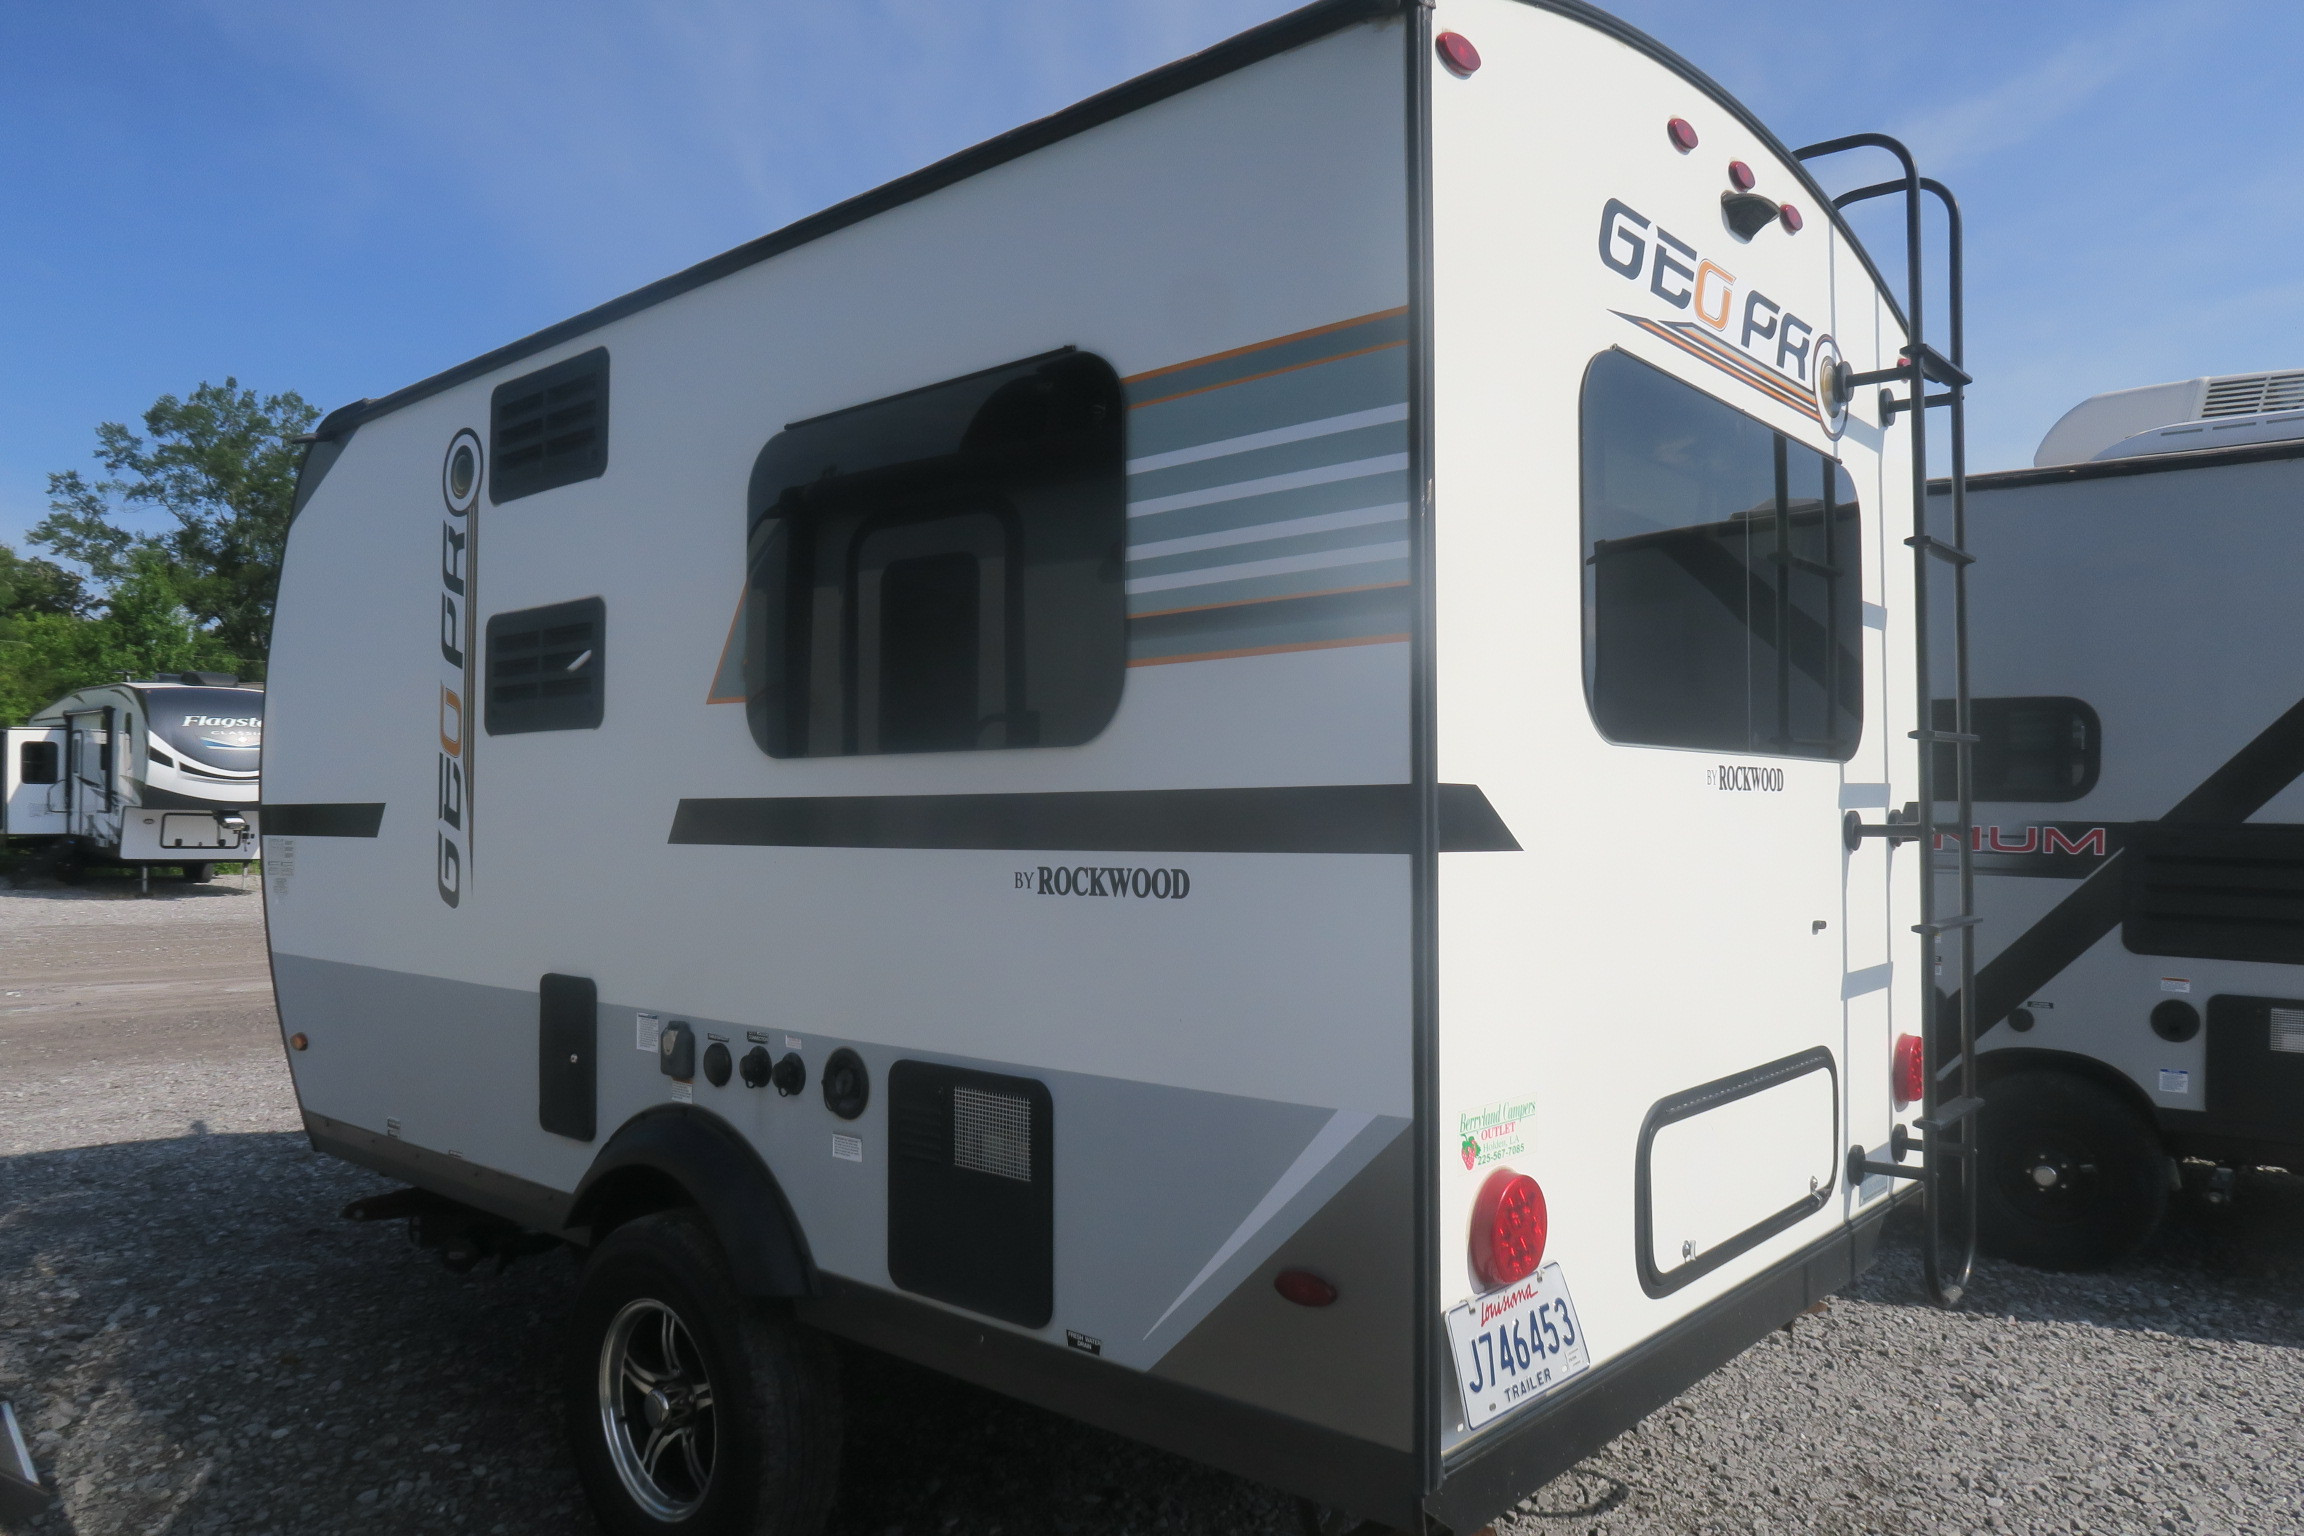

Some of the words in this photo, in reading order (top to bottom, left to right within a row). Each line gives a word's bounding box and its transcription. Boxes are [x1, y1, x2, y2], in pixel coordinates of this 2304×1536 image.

[1599, 198, 1736, 331] GEO
[438, 680, 462, 909] GEO
[1706, 769, 1717, 785] BY
[1718, 765, 1784, 792] ROCKWOOD
[1014, 871, 1034, 889] BY
[1037, 866, 1190, 899] ROCKWOOD
[1460, 1104, 1501, 1134] Berryland
[1503, 1101, 1536, 1122] Campers
[1481, 1121, 1516, 1140] OUTLET
[1478, 1143, 1525, 1165] 225-567-7085
[1481, 1284, 1538, 1327] Louisiana
[1469, 1297, 1576, 1393] J746453
[1504, 1368, 1552, 1402] TRAILER
